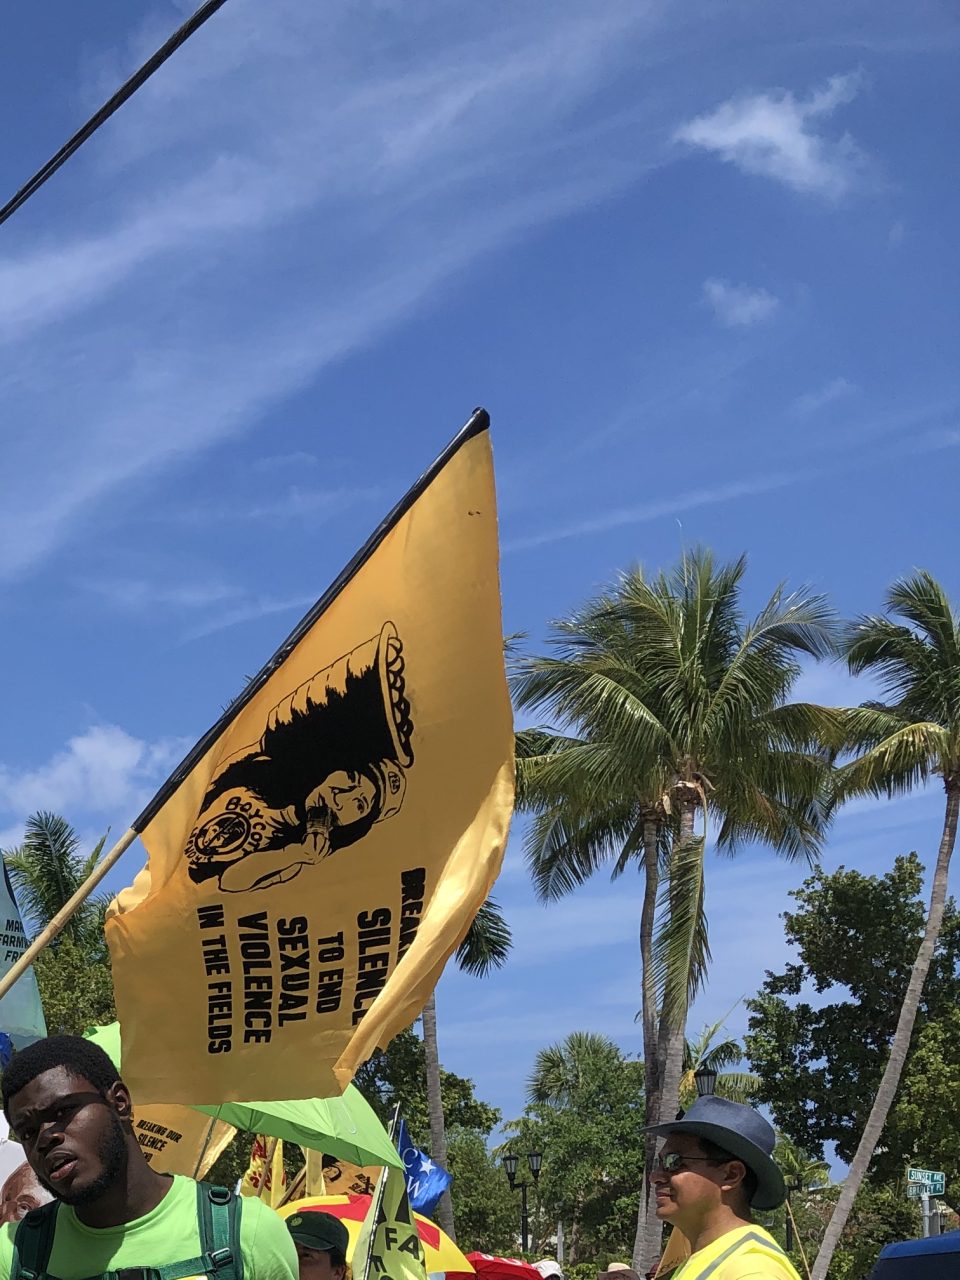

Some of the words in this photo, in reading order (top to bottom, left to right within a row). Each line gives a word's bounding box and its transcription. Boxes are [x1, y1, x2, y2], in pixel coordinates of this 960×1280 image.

[225, 796, 266, 856] BOYCOTT
[197, 904, 225, 929] IN
[396, 867, 426, 965] BREAK
[201, 934, 231, 977] THE
[276, 916, 310, 1028] SEXUAL
[317, 931, 345, 963] TO
[237, 911, 272, 1044] VIOLENCE
[316, 967, 345, 1014] END
[208, 981, 233, 1055] FIELDS
[138, 1133, 168, 1152] SILENCE
